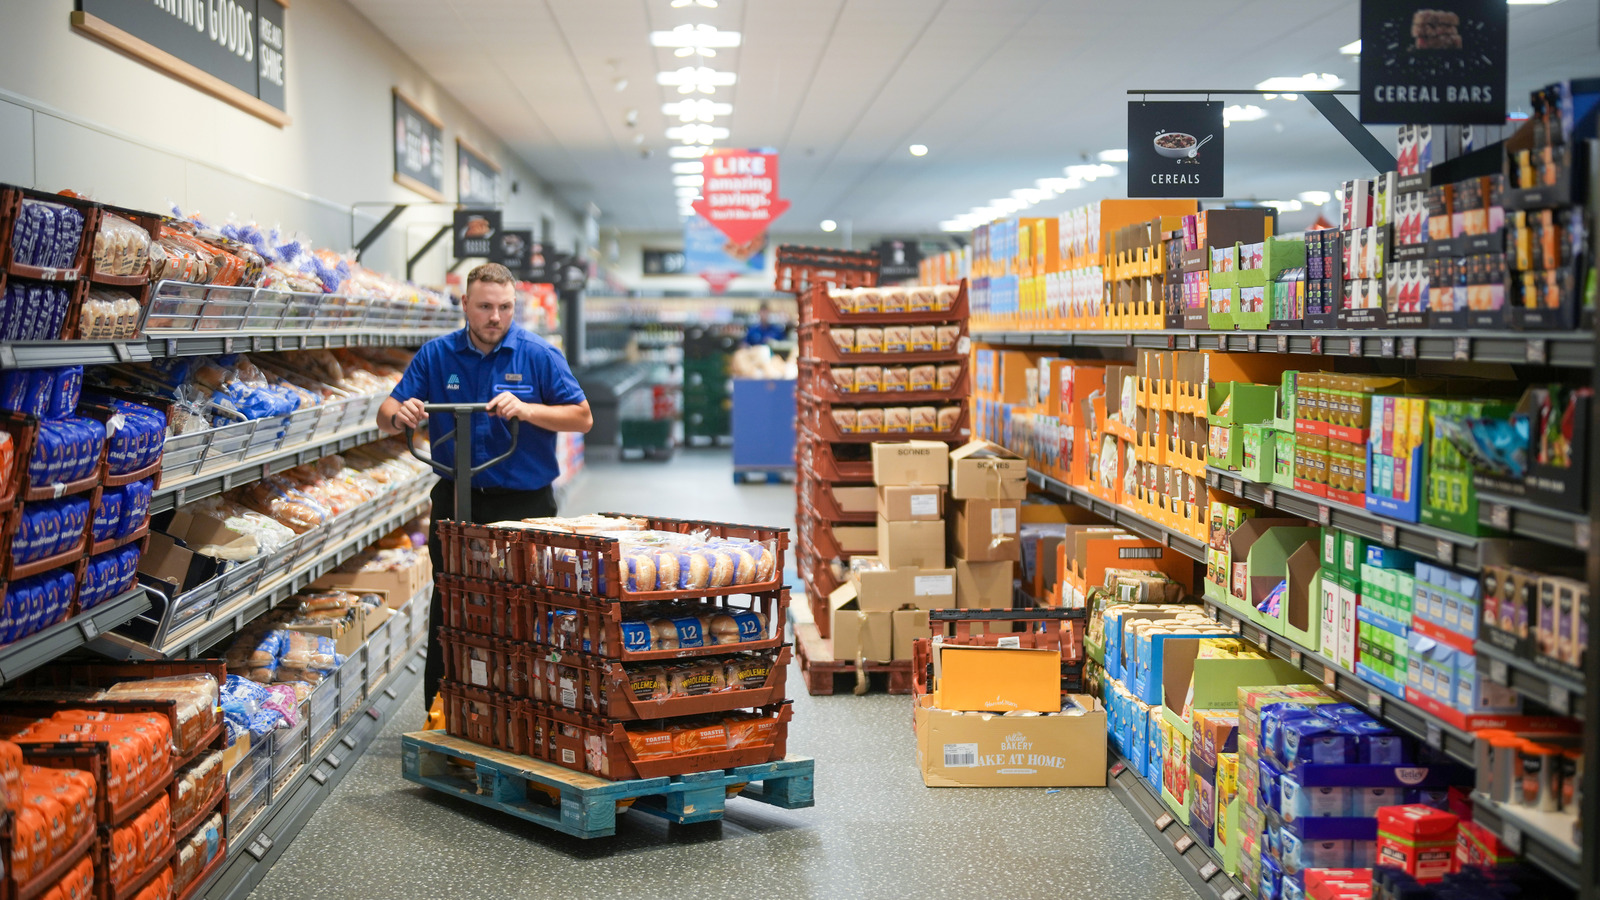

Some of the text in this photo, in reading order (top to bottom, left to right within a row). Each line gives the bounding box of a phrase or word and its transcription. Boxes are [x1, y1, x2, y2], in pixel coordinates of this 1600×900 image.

[208, 0, 254, 62] GOODS
[260, 42, 283, 86] SHINE
[1374, 85, 1492, 103] CEREAL BARS
[714, 156, 766, 176] LIKE
[708, 175, 772, 194] amazing
[1151, 173, 1200, 185] CEREALS
[709, 191, 771, 209] savings.
[680, 625, 698, 640] 12
[742, 620, 758, 635] 12
[629, 630, 646, 645] 12
[682, 675, 718, 688] WHOLEMEAL
[738, 668, 770, 680] WHOLEMEA
[645, 735, 670, 743] TOASTIE
[700, 728, 724, 737] TOASTIE
[1001, 742, 1033, 750] BAKERY
[977, 753, 1066, 768] AKE AT HOME
[1400, 769, 1425, 781] Tetley
